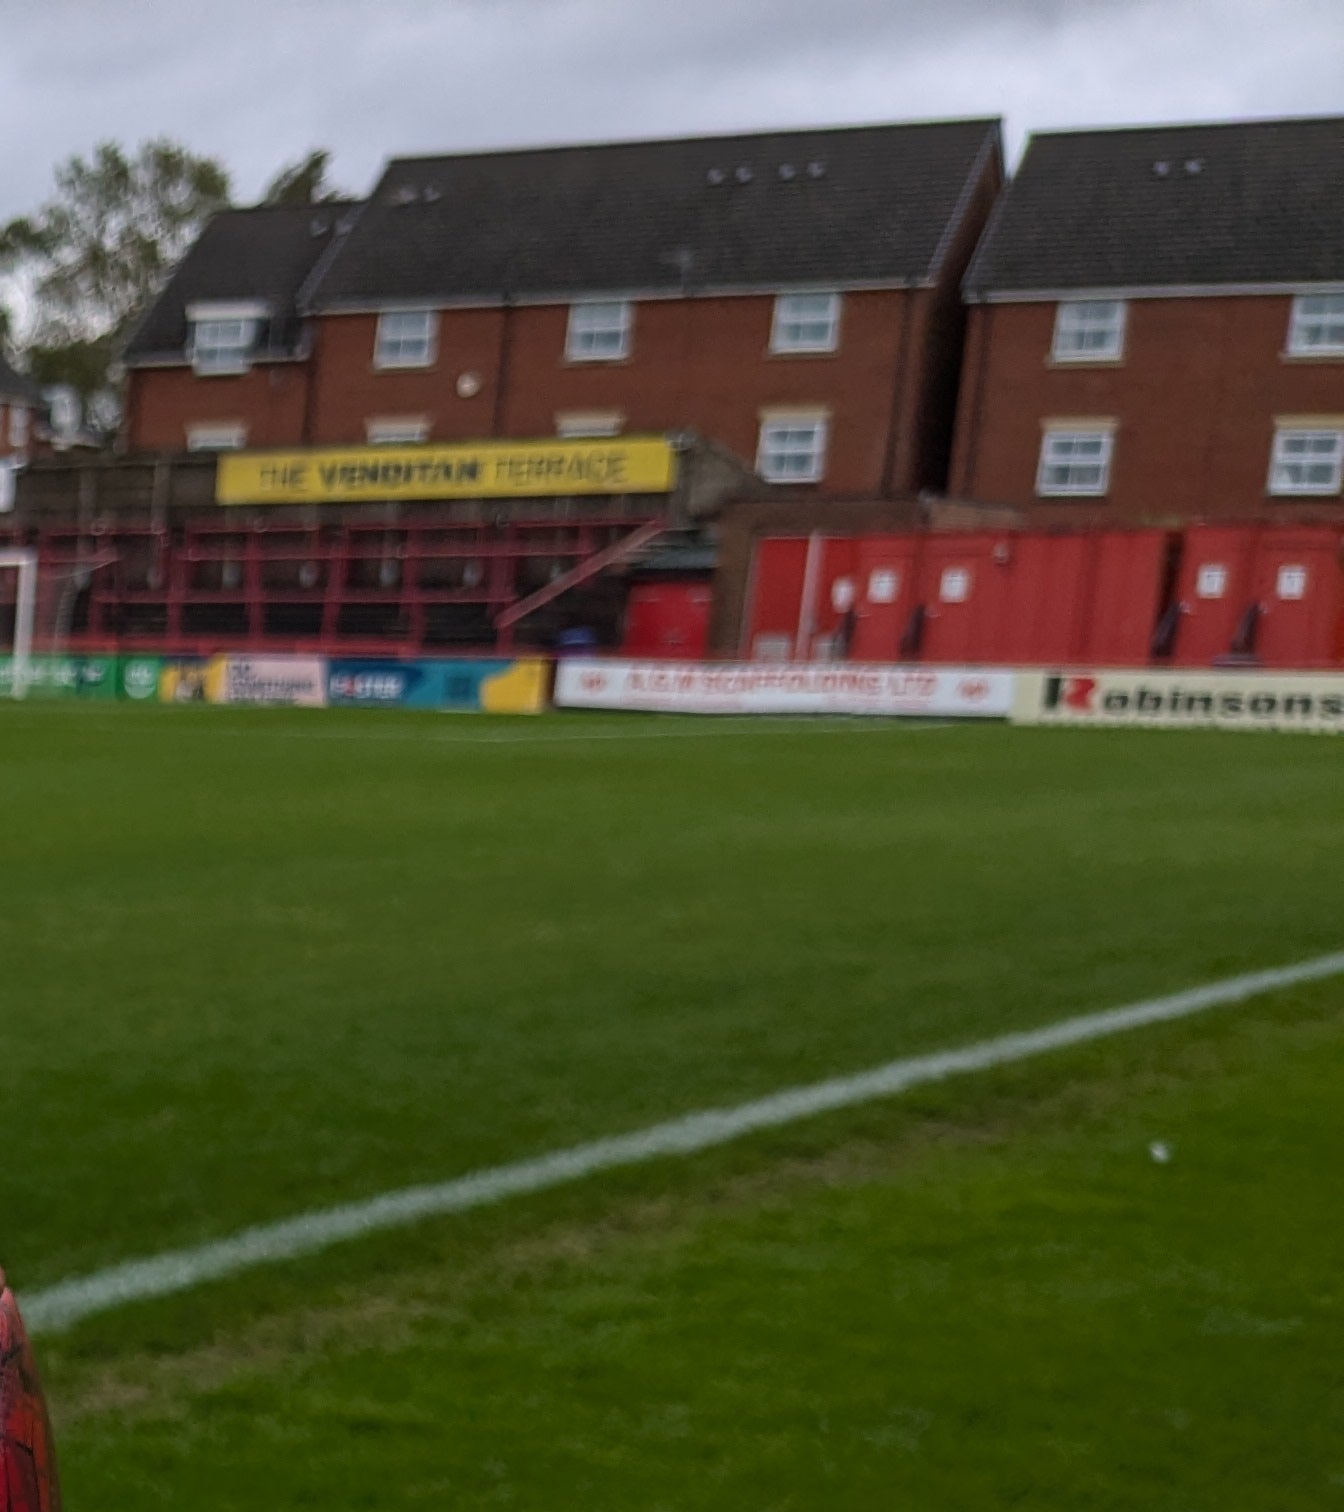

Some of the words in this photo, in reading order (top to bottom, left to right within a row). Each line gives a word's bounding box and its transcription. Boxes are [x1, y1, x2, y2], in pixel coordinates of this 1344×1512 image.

[259, 463, 306, 491] THE
[318, 457, 483, 490] VENDITAN
[495, 452, 629, 486] TERRACE
[1044, 676, 1344, 716] Robinsons
